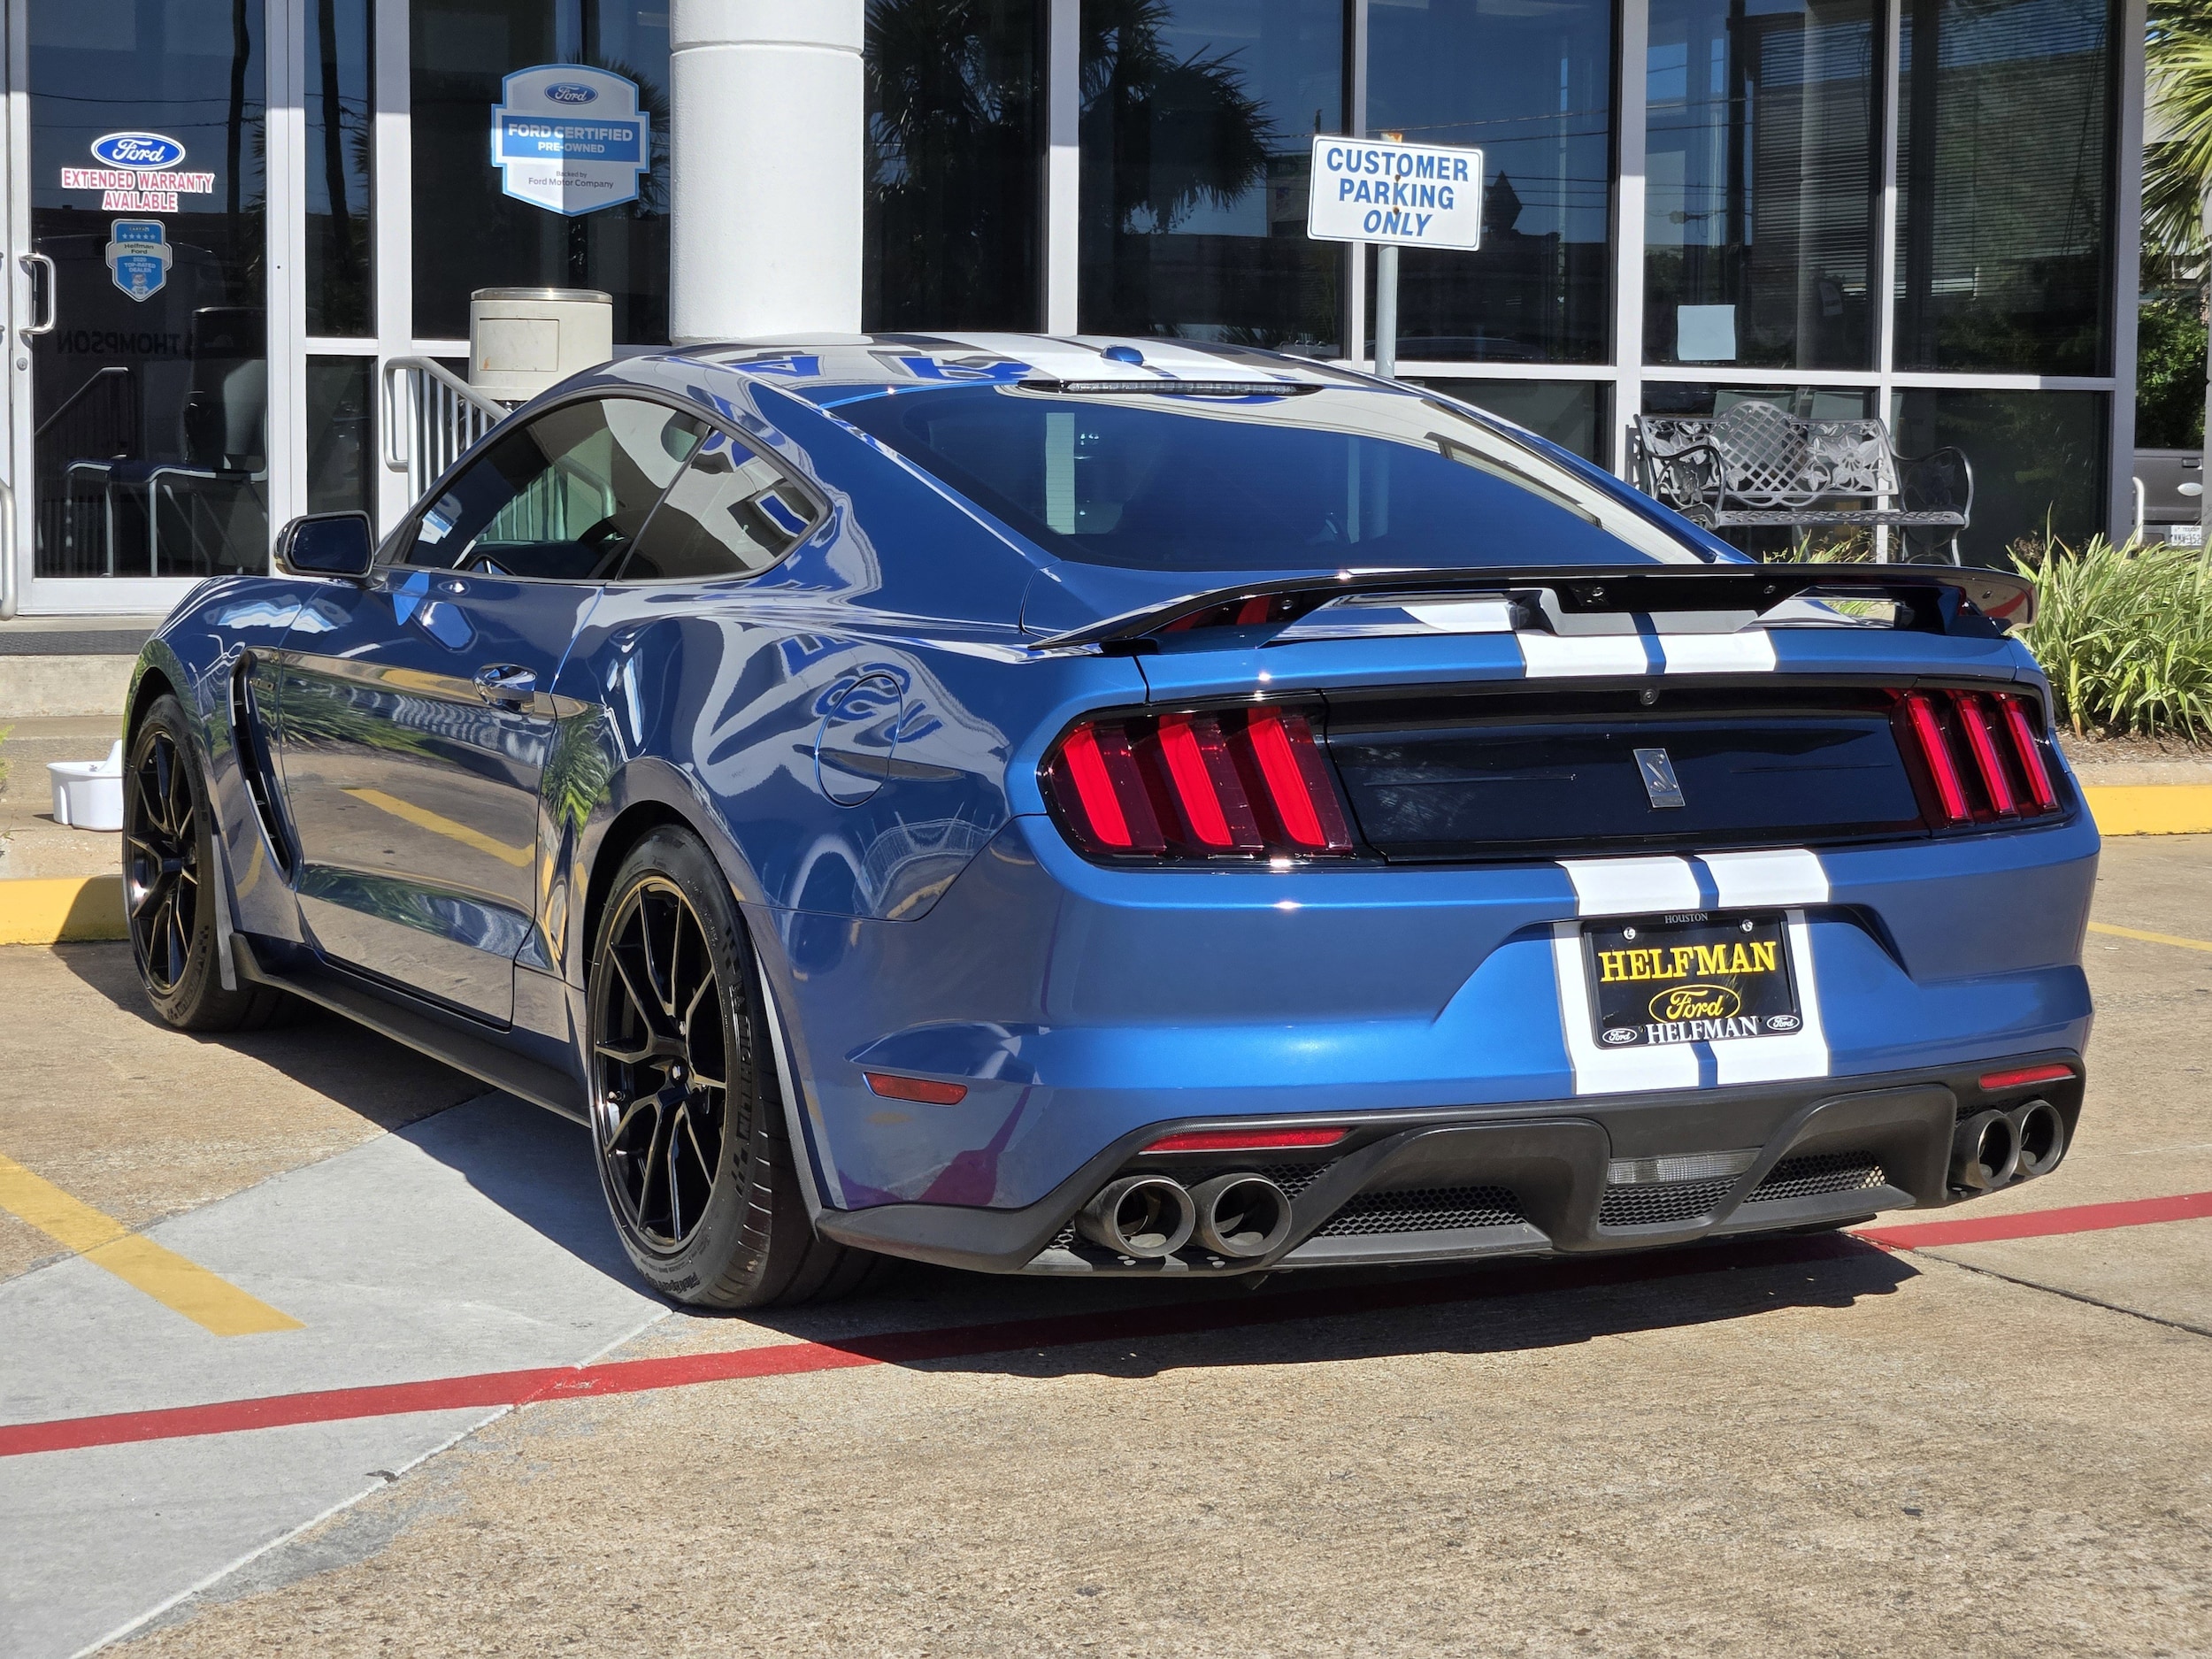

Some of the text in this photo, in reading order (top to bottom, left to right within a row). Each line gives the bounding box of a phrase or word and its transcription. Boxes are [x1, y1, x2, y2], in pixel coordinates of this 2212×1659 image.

[554, 84, 588, 102] Ford
[508, 123, 634, 142] FORD CERTIFIED
[111, 138, 166, 163] Ford
[538, 142, 605, 154] PRE-OWNED
[1326, 147, 1469, 182] CUSTOMER
[64, 170, 214, 192] EXTENDED WARRANTY
[528, 177, 548, 186] Ford
[574, 180, 614, 189] Company
[104, 192, 177, 210] AVAILABLE
[1339, 178, 1455, 211] PARKING
[1363, 210, 1433, 237] ONLY
[1664, 913, 1709, 925] HOUSTON
[1597, 941, 1777, 983] HELFMAN
[1665, 989, 1724, 1020] Ford
[1645, 1015, 1760, 1045] HELFMAN
